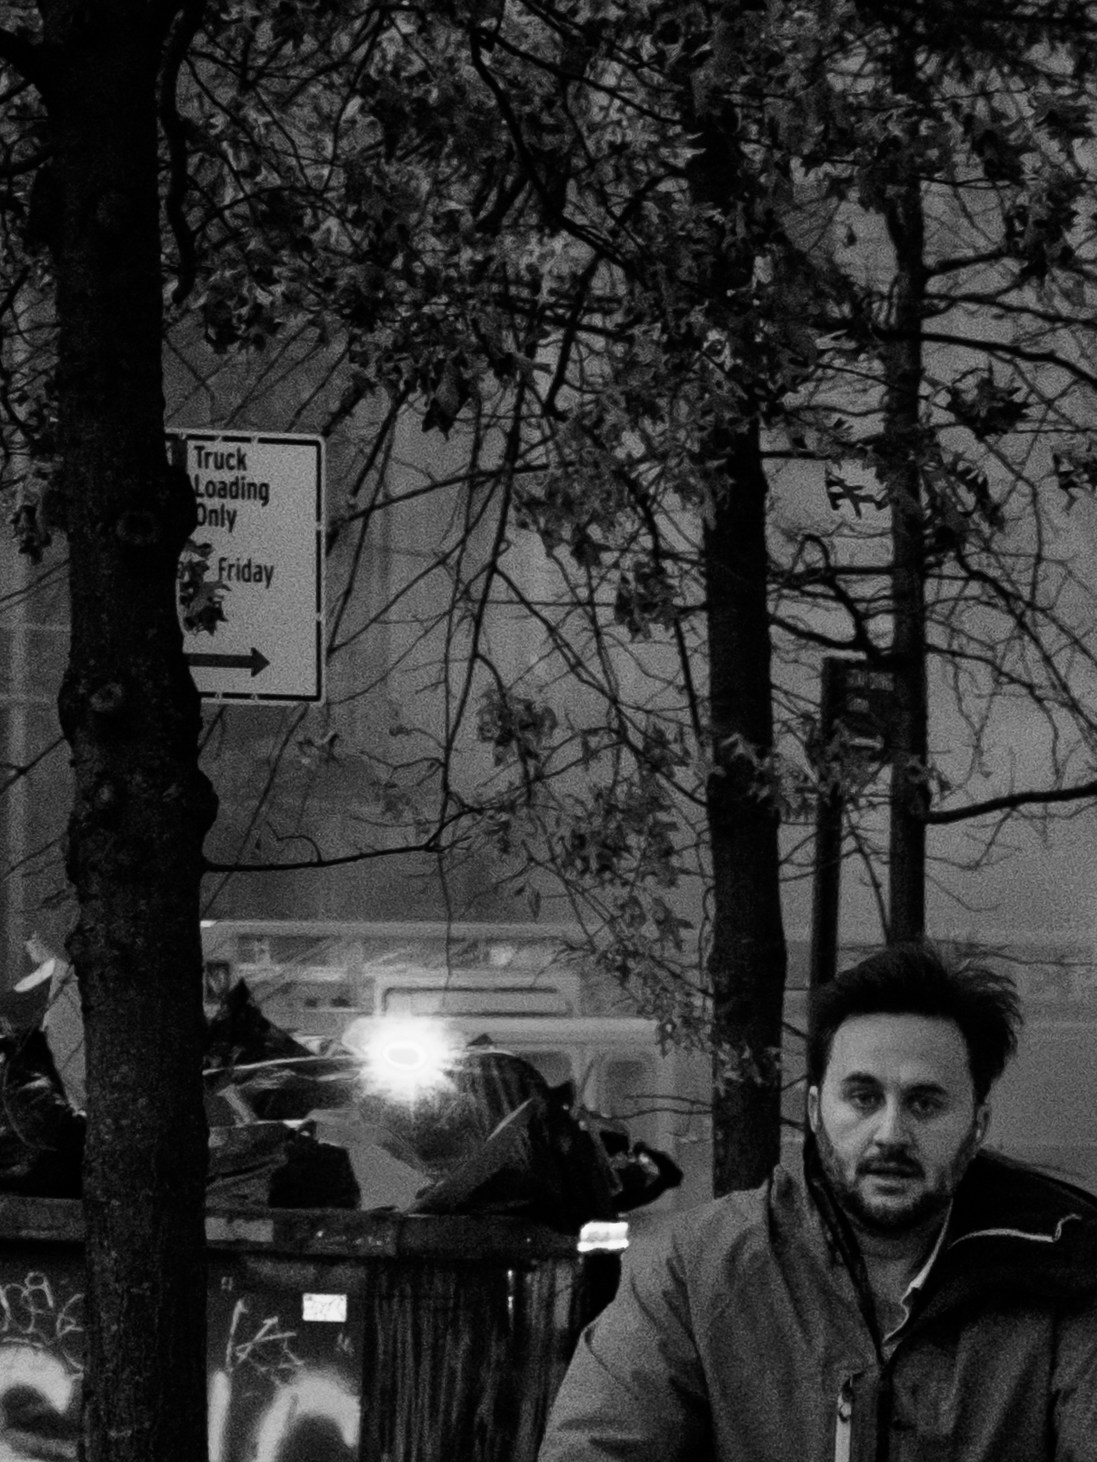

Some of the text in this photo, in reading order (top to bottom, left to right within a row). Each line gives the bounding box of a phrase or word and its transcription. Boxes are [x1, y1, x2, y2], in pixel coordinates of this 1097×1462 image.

[194, 446, 248, 471] Truck
[194, 474, 270, 507] Loading
[196, 503, 237, 533] Only
[218, 557, 274, 589] Friday
